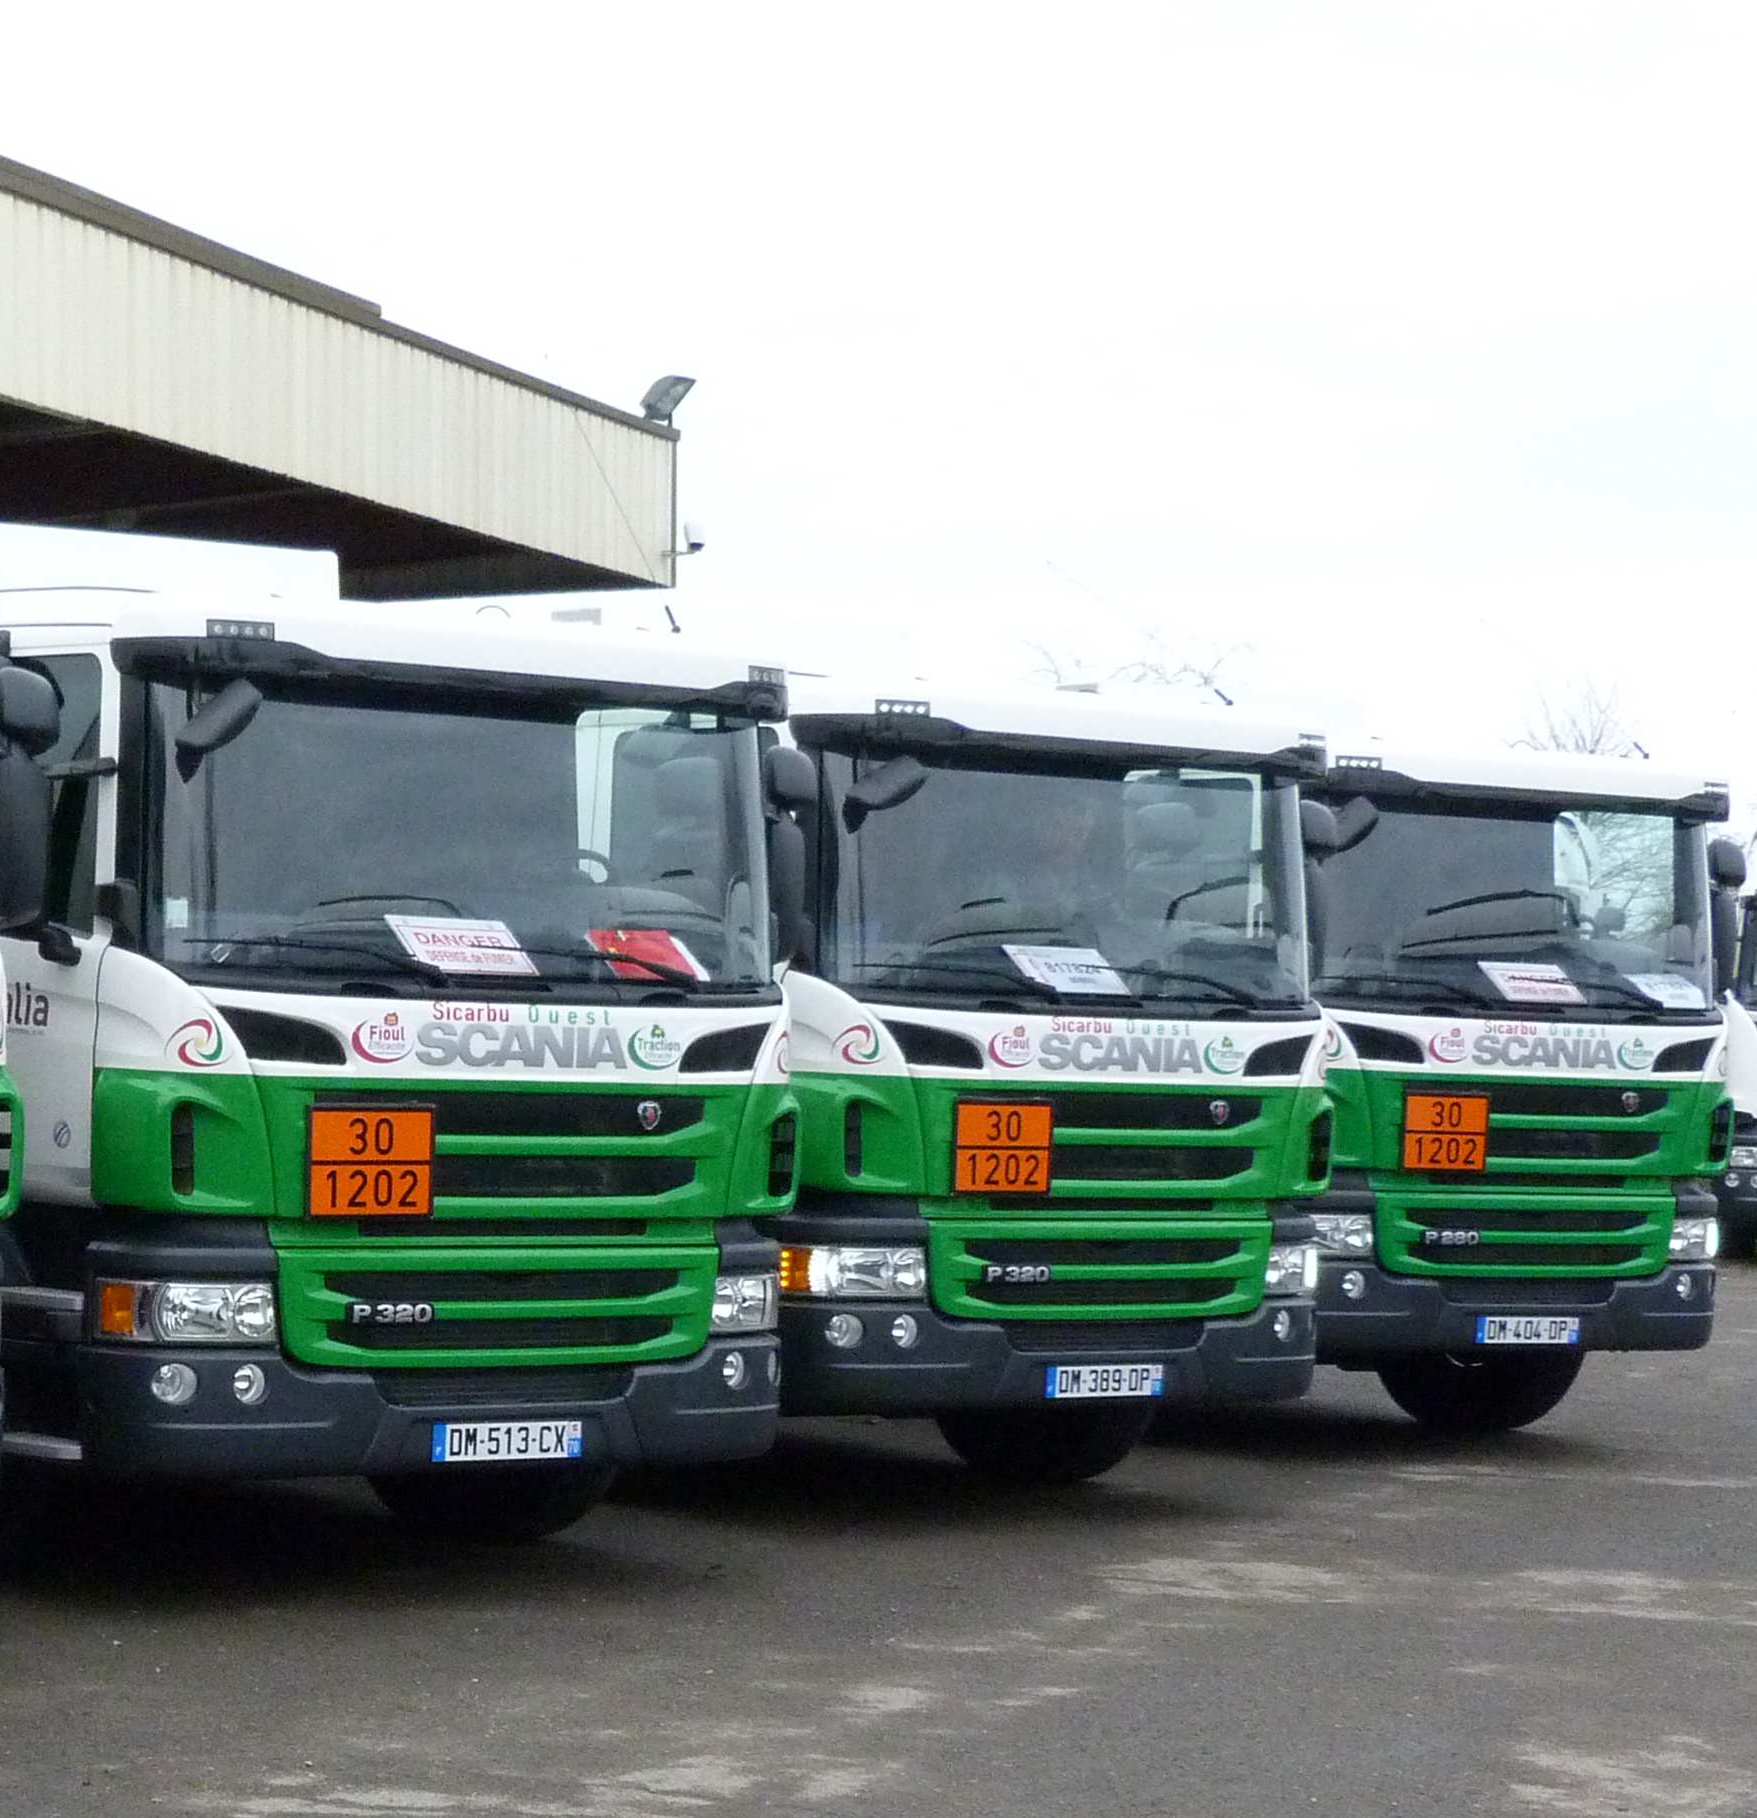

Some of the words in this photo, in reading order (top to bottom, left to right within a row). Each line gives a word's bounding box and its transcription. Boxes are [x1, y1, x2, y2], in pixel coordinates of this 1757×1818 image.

[414, 932, 504, 947] DANGER
[432, 1001, 510, 1022] Sicarbu
[528, 1004, 611, 1026] Ouest
[369, 1026, 405, 1041] Fioul
[1051, 1017, 1112, 1034] Sicarbu
[1126, 1020, 1190, 1037] Ouest
[1484, 1020, 1537, 1036] Sicarbu
[1549, 1024, 1606, 1038] Ouest
[415, 1022, 628, 1069] SCANIA
[638, 1037, 681, 1052] Traction
[1002, 1036, 1030, 1050] Fioul
[1038, 1033, 1203, 1073] SCANIA
[1472, 1035, 1616, 1069] SCANIA
[987, 1110, 1022, 1141] 30
[1431, 1101, 1462, 1127] 30
[349, 1117, 394, 1155] 30
[1415, 1137, 1477, 1165] 1202
[968, 1153, 1040, 1185] 1202
[326, 1169, 418, 1208] 1202
[1425, 1231, 1438, 1244] P
[987, 1266, 1002, 1282] P
[1005, 1266, 1050, 1282] 320
[352, 1304, 372, 1323] P
[375, 1303, 433, 1323] 320
[1487, 1320, 1567, 1340] DM-404-DP
[1059, 1368, 1150, 1393] DM-389-DP
[449, 1425, 566, 1456] DM-513-CX
